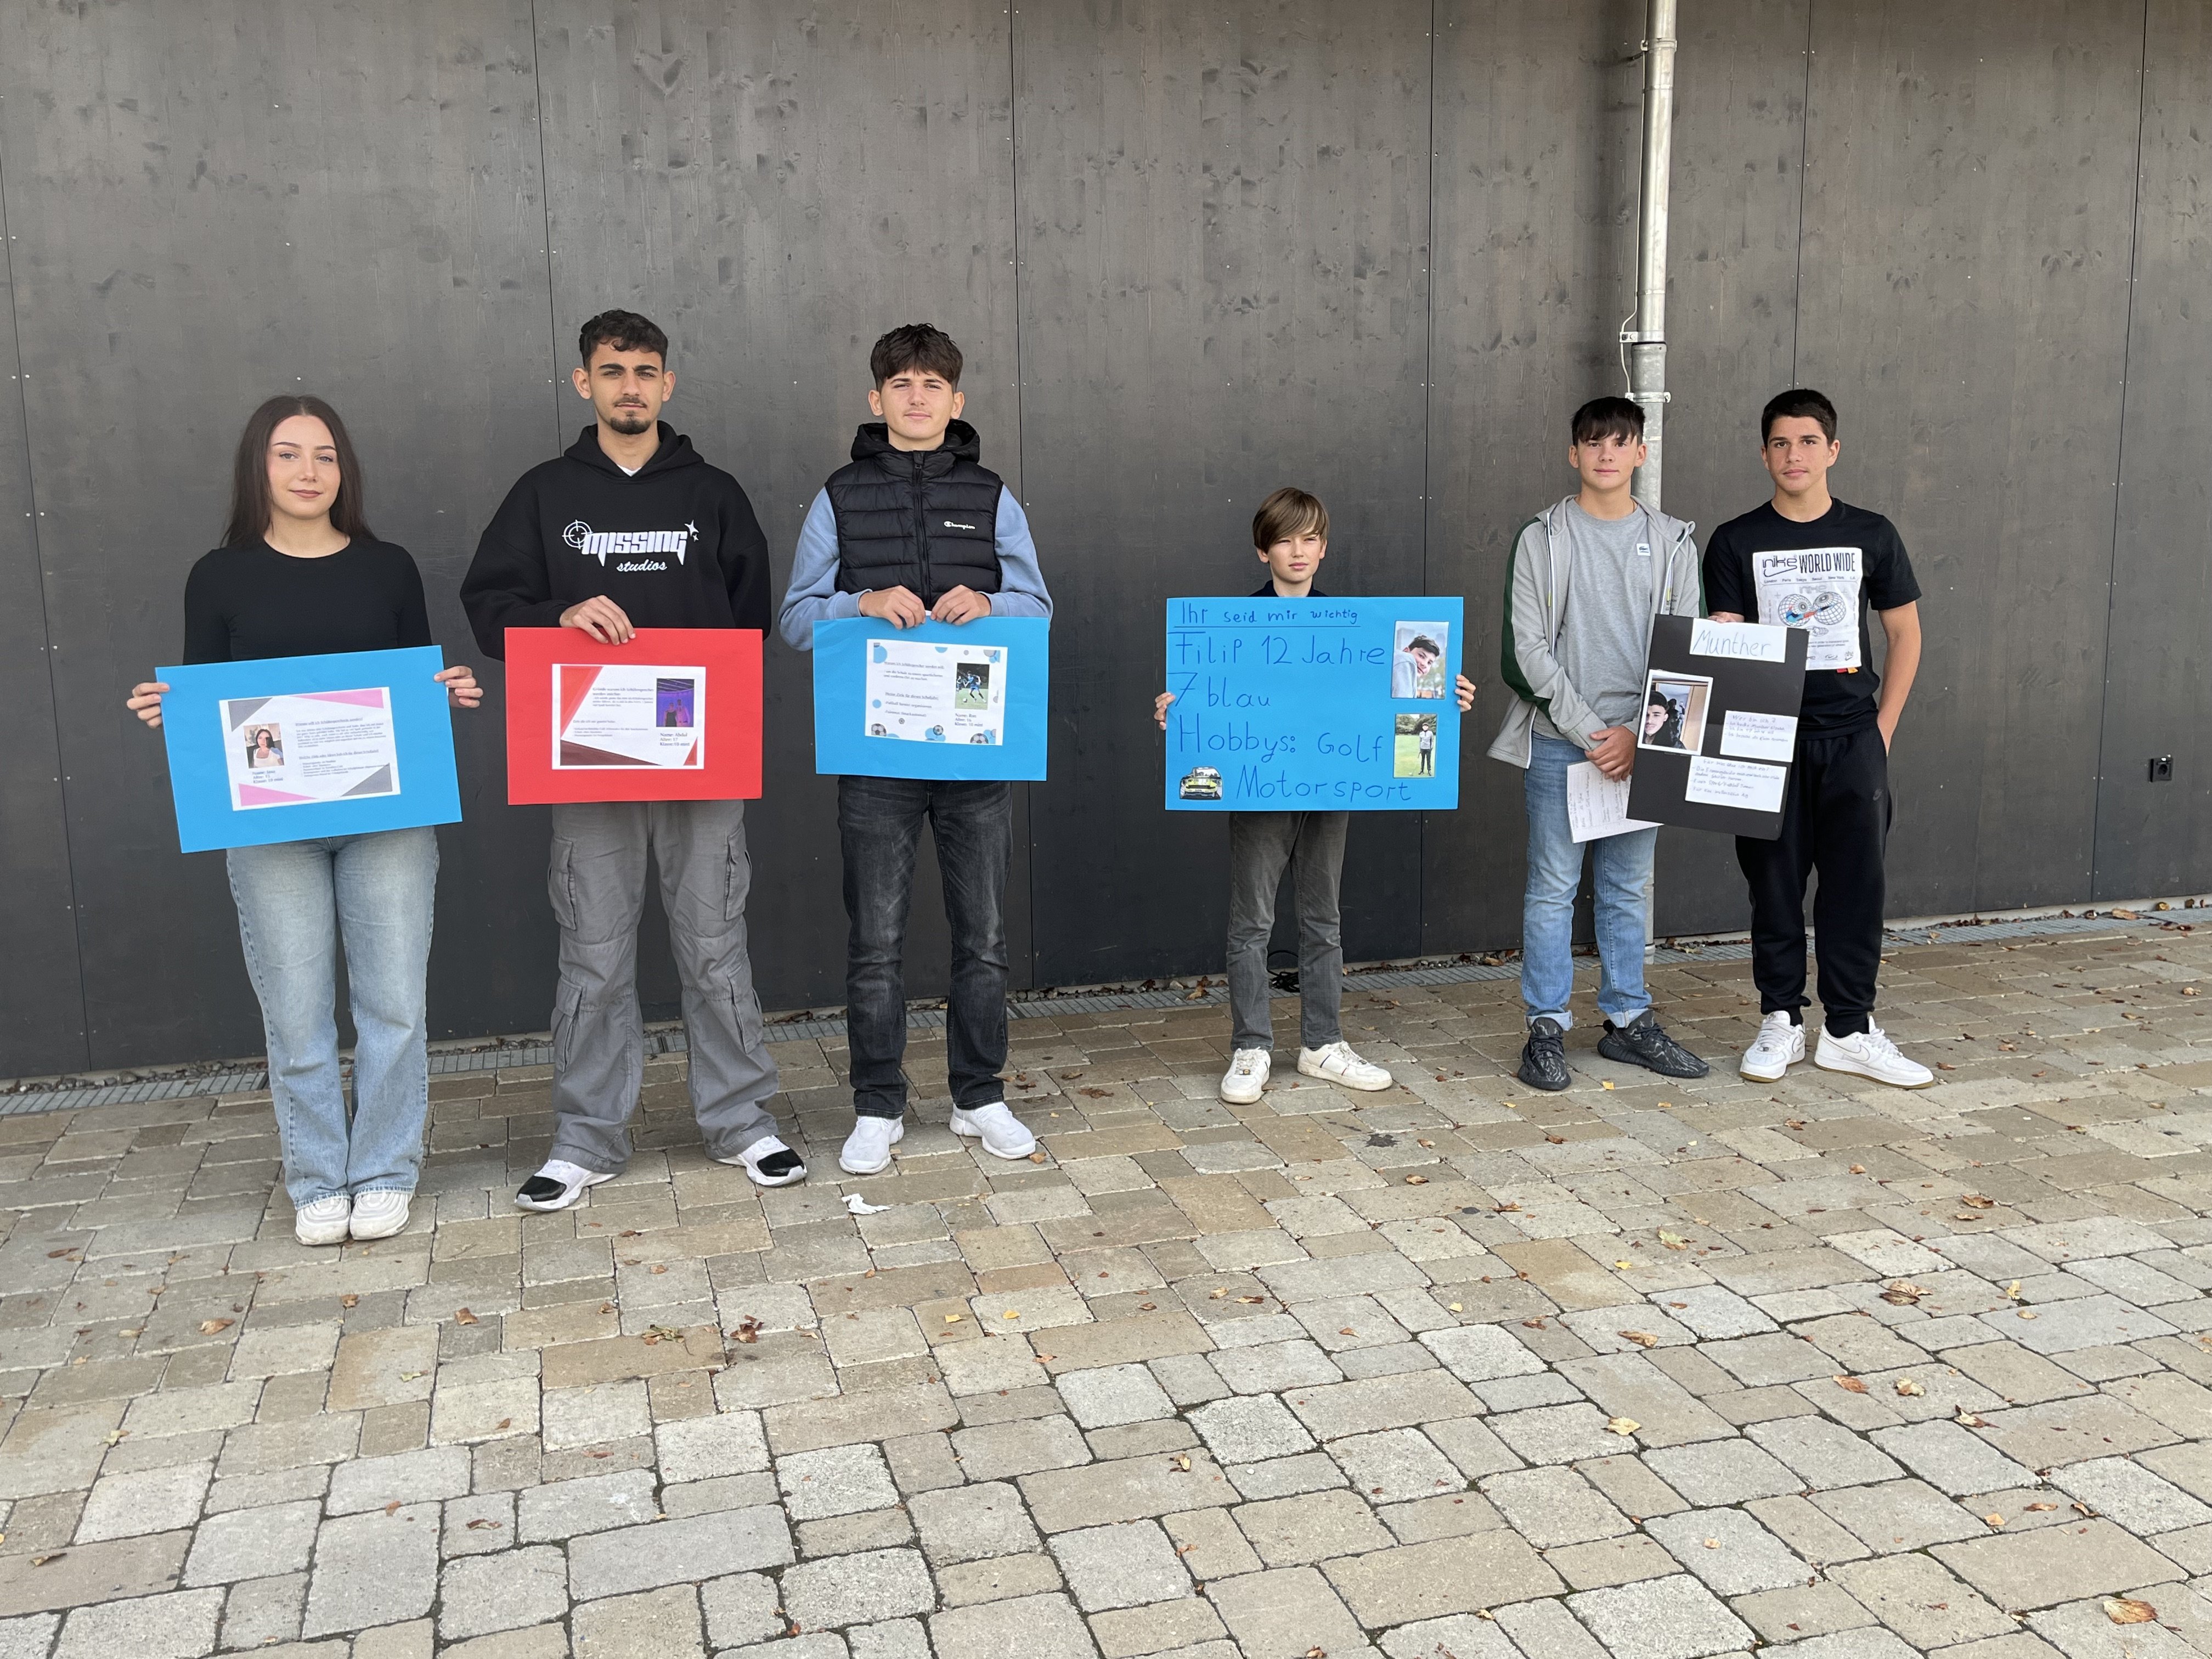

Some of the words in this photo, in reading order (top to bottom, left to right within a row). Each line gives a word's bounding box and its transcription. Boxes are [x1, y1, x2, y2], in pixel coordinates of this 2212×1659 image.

[944, 521, 975, 530] Champion
[582, 531, 688, 566] MISSING
[616, 559, 667, 572] studios
[1799, 553, 1832, 574] WORLD
[1833, 552, 1855, 572] WIDE
[1182, 601, 1208, 624] Ihr
[1223, 611, 1257, 623] seid
[1268, 610, 1297, 622] mir
[1310, 609, 1358, 625] wichtig
[1261, 635, 1293, 665] 12
[1302, 635, 1385, 665] Jahre
[1692, 630, 1770, 656] Munther
[1167, 672, 1198, 707] 7
[1208, 676, 1271, 708] blau
[1180, 714, 1296, 763] Hobbys:
[1318, 732, 1384, 763] Golf
[1236, 765, 1412, 803] Motorsport
